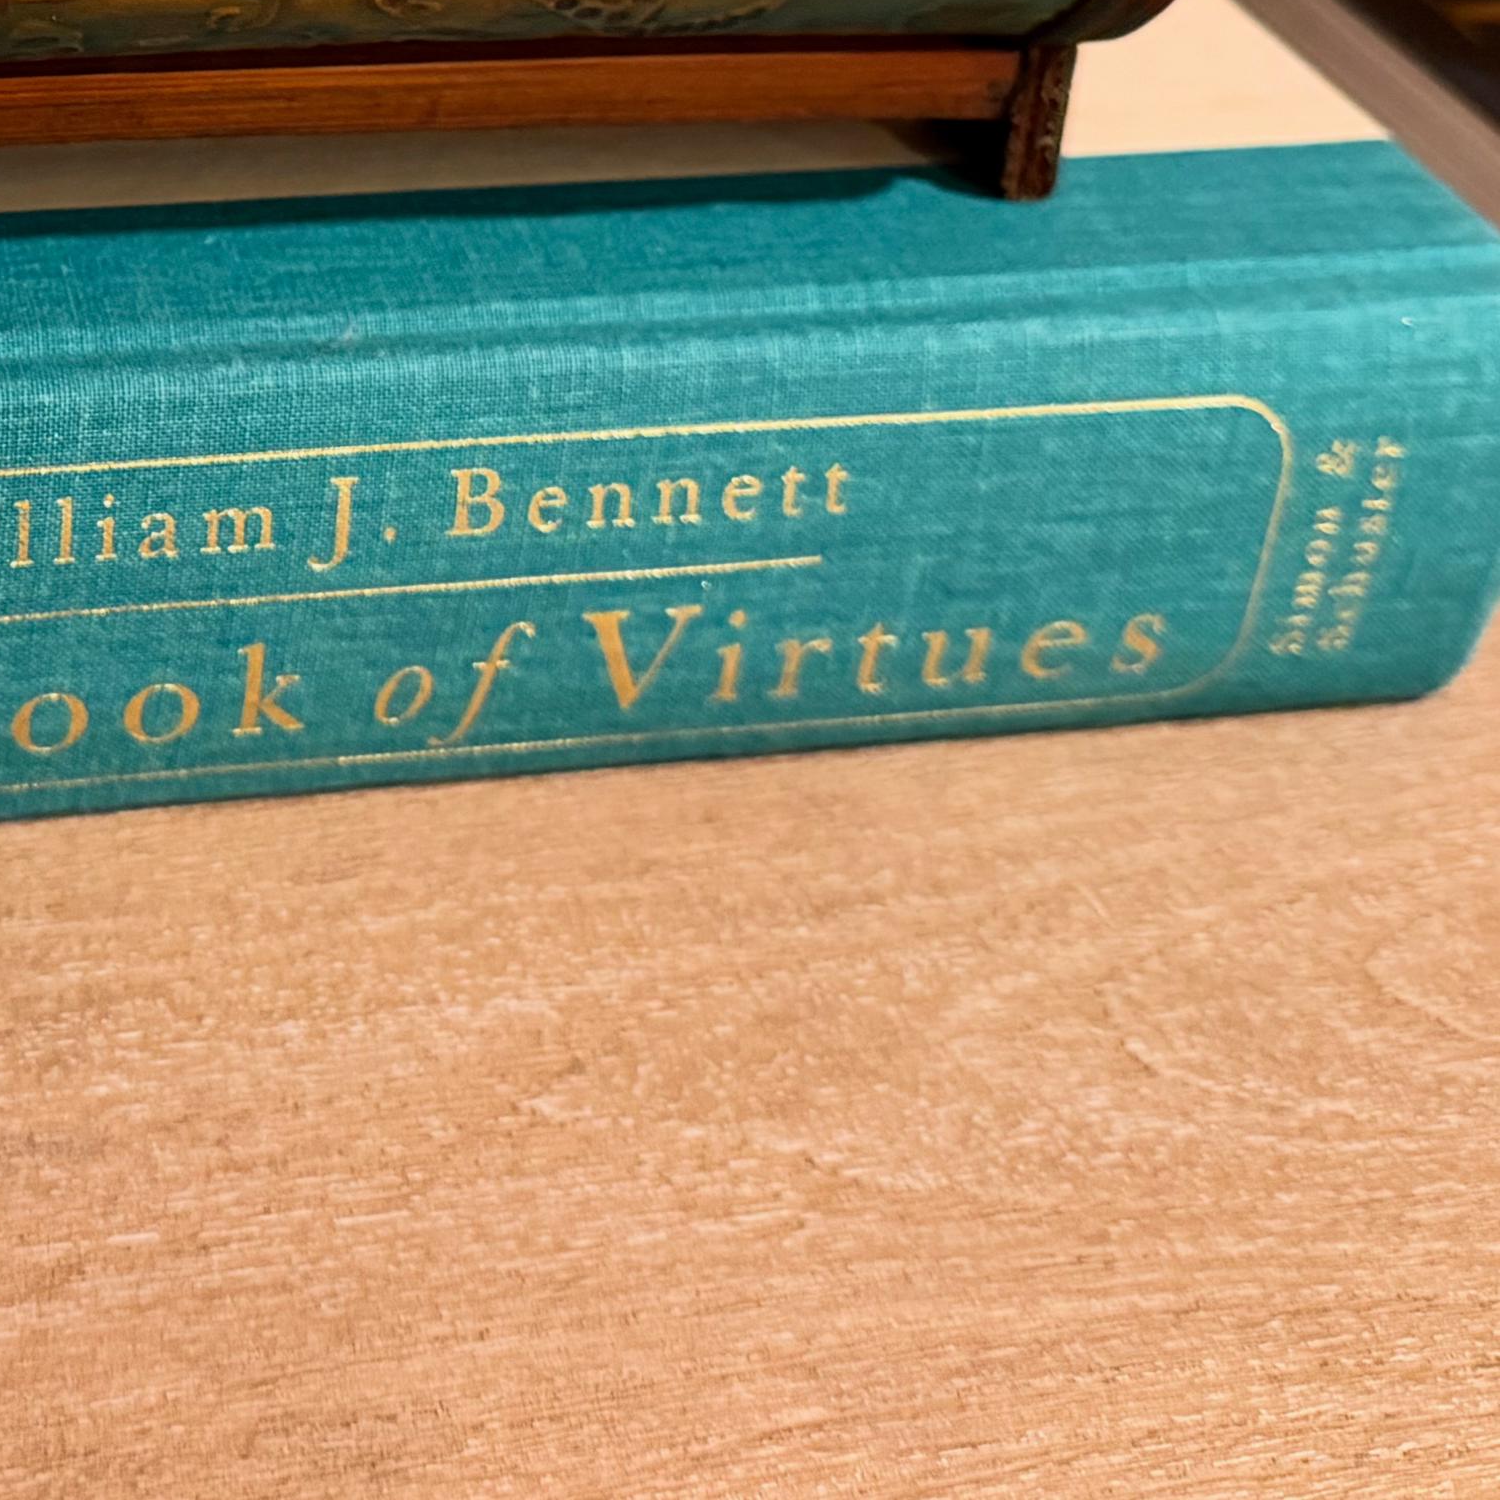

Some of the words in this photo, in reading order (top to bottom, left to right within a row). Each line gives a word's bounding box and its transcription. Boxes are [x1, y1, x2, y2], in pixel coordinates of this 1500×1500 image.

[307, 476, 398, 572] J.
[446, 463, 851, 539] Bennett
[373, 621, 536, 746] of
[582, 603, 1166, 712] Virtues
